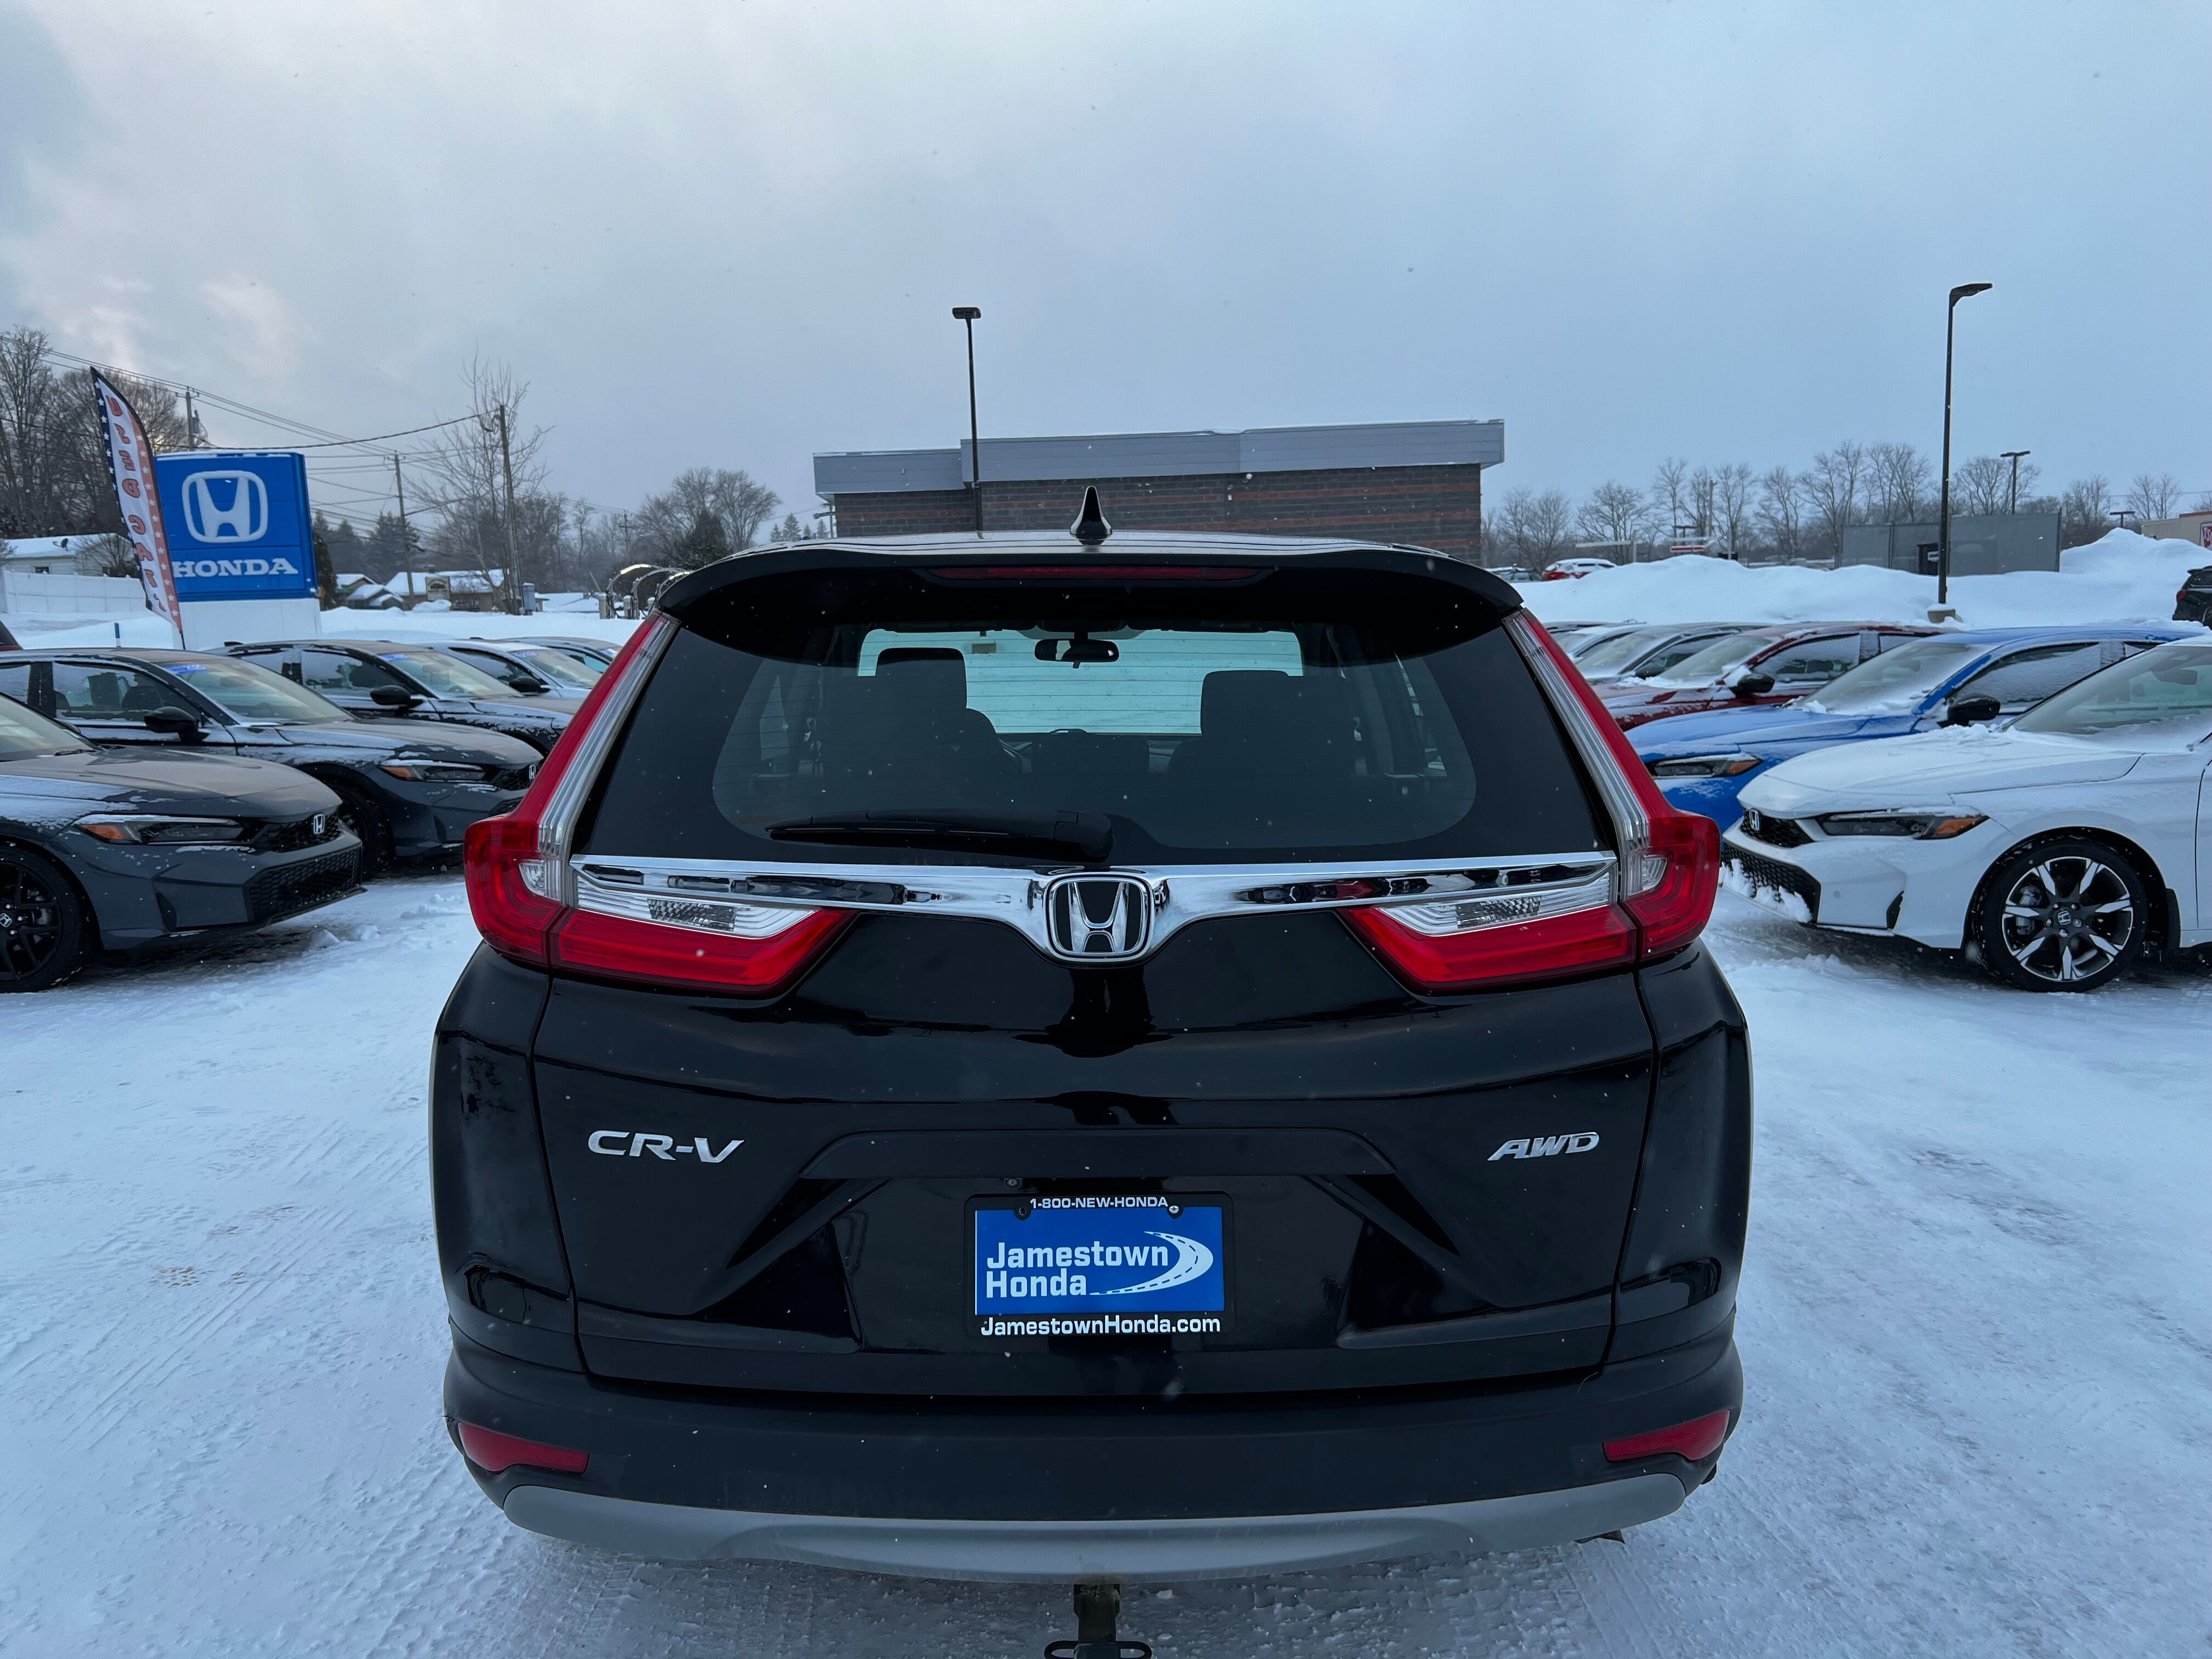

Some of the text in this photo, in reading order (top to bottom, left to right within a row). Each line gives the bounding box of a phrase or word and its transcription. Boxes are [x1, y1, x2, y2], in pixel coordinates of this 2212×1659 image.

[171, 557, 299, 578] HONDA
[588, 1130, 744, 1163] CR-V
[1487, 1132, 1600, 1161] AWD
[1030, 1196, 1169, 1209] 1-800-NEW-HONDA
[986, 1240, 1169, 1269] Jamestown
[986, 1268, 1087, 1298] Honda
[980, 1314, 1221, 1336] JamestownHonda.com
